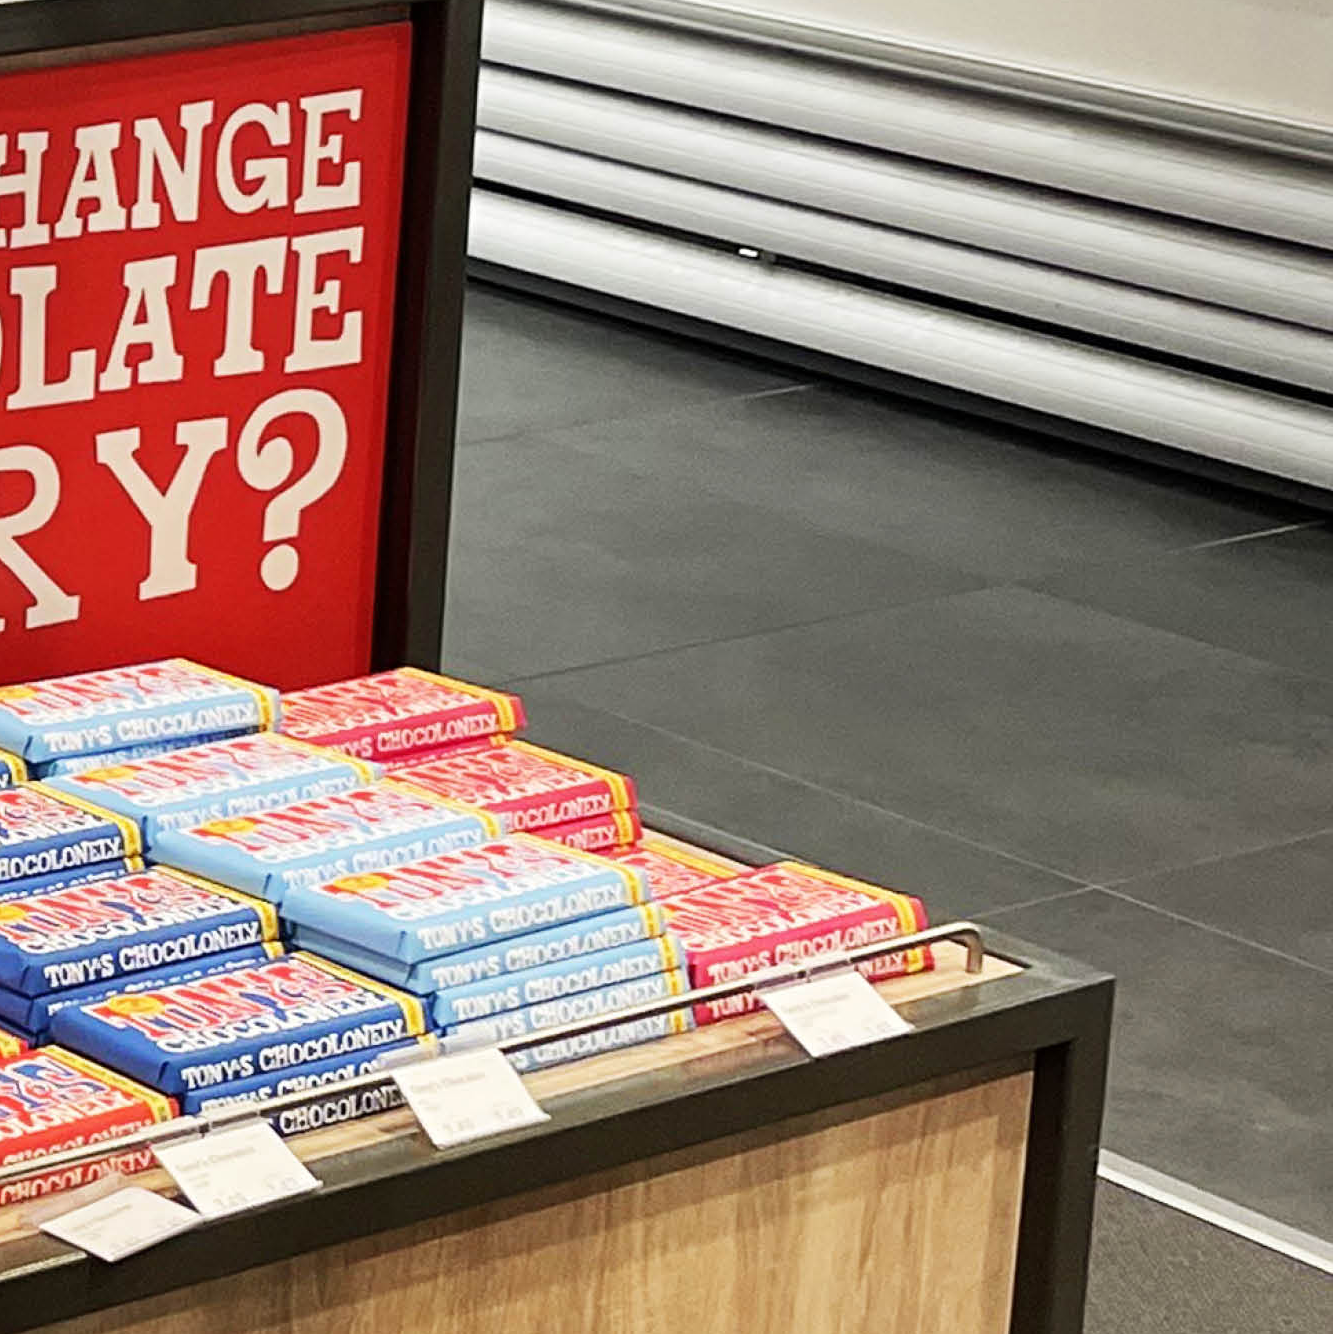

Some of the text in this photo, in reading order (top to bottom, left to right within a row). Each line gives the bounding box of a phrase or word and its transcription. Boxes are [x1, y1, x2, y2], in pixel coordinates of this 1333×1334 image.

[44, 953, 114, 988] TONY'S
[181, 1053, 254, 1090] TONY'S
[280, 1086, 404, 1134] CHOCOLONE
